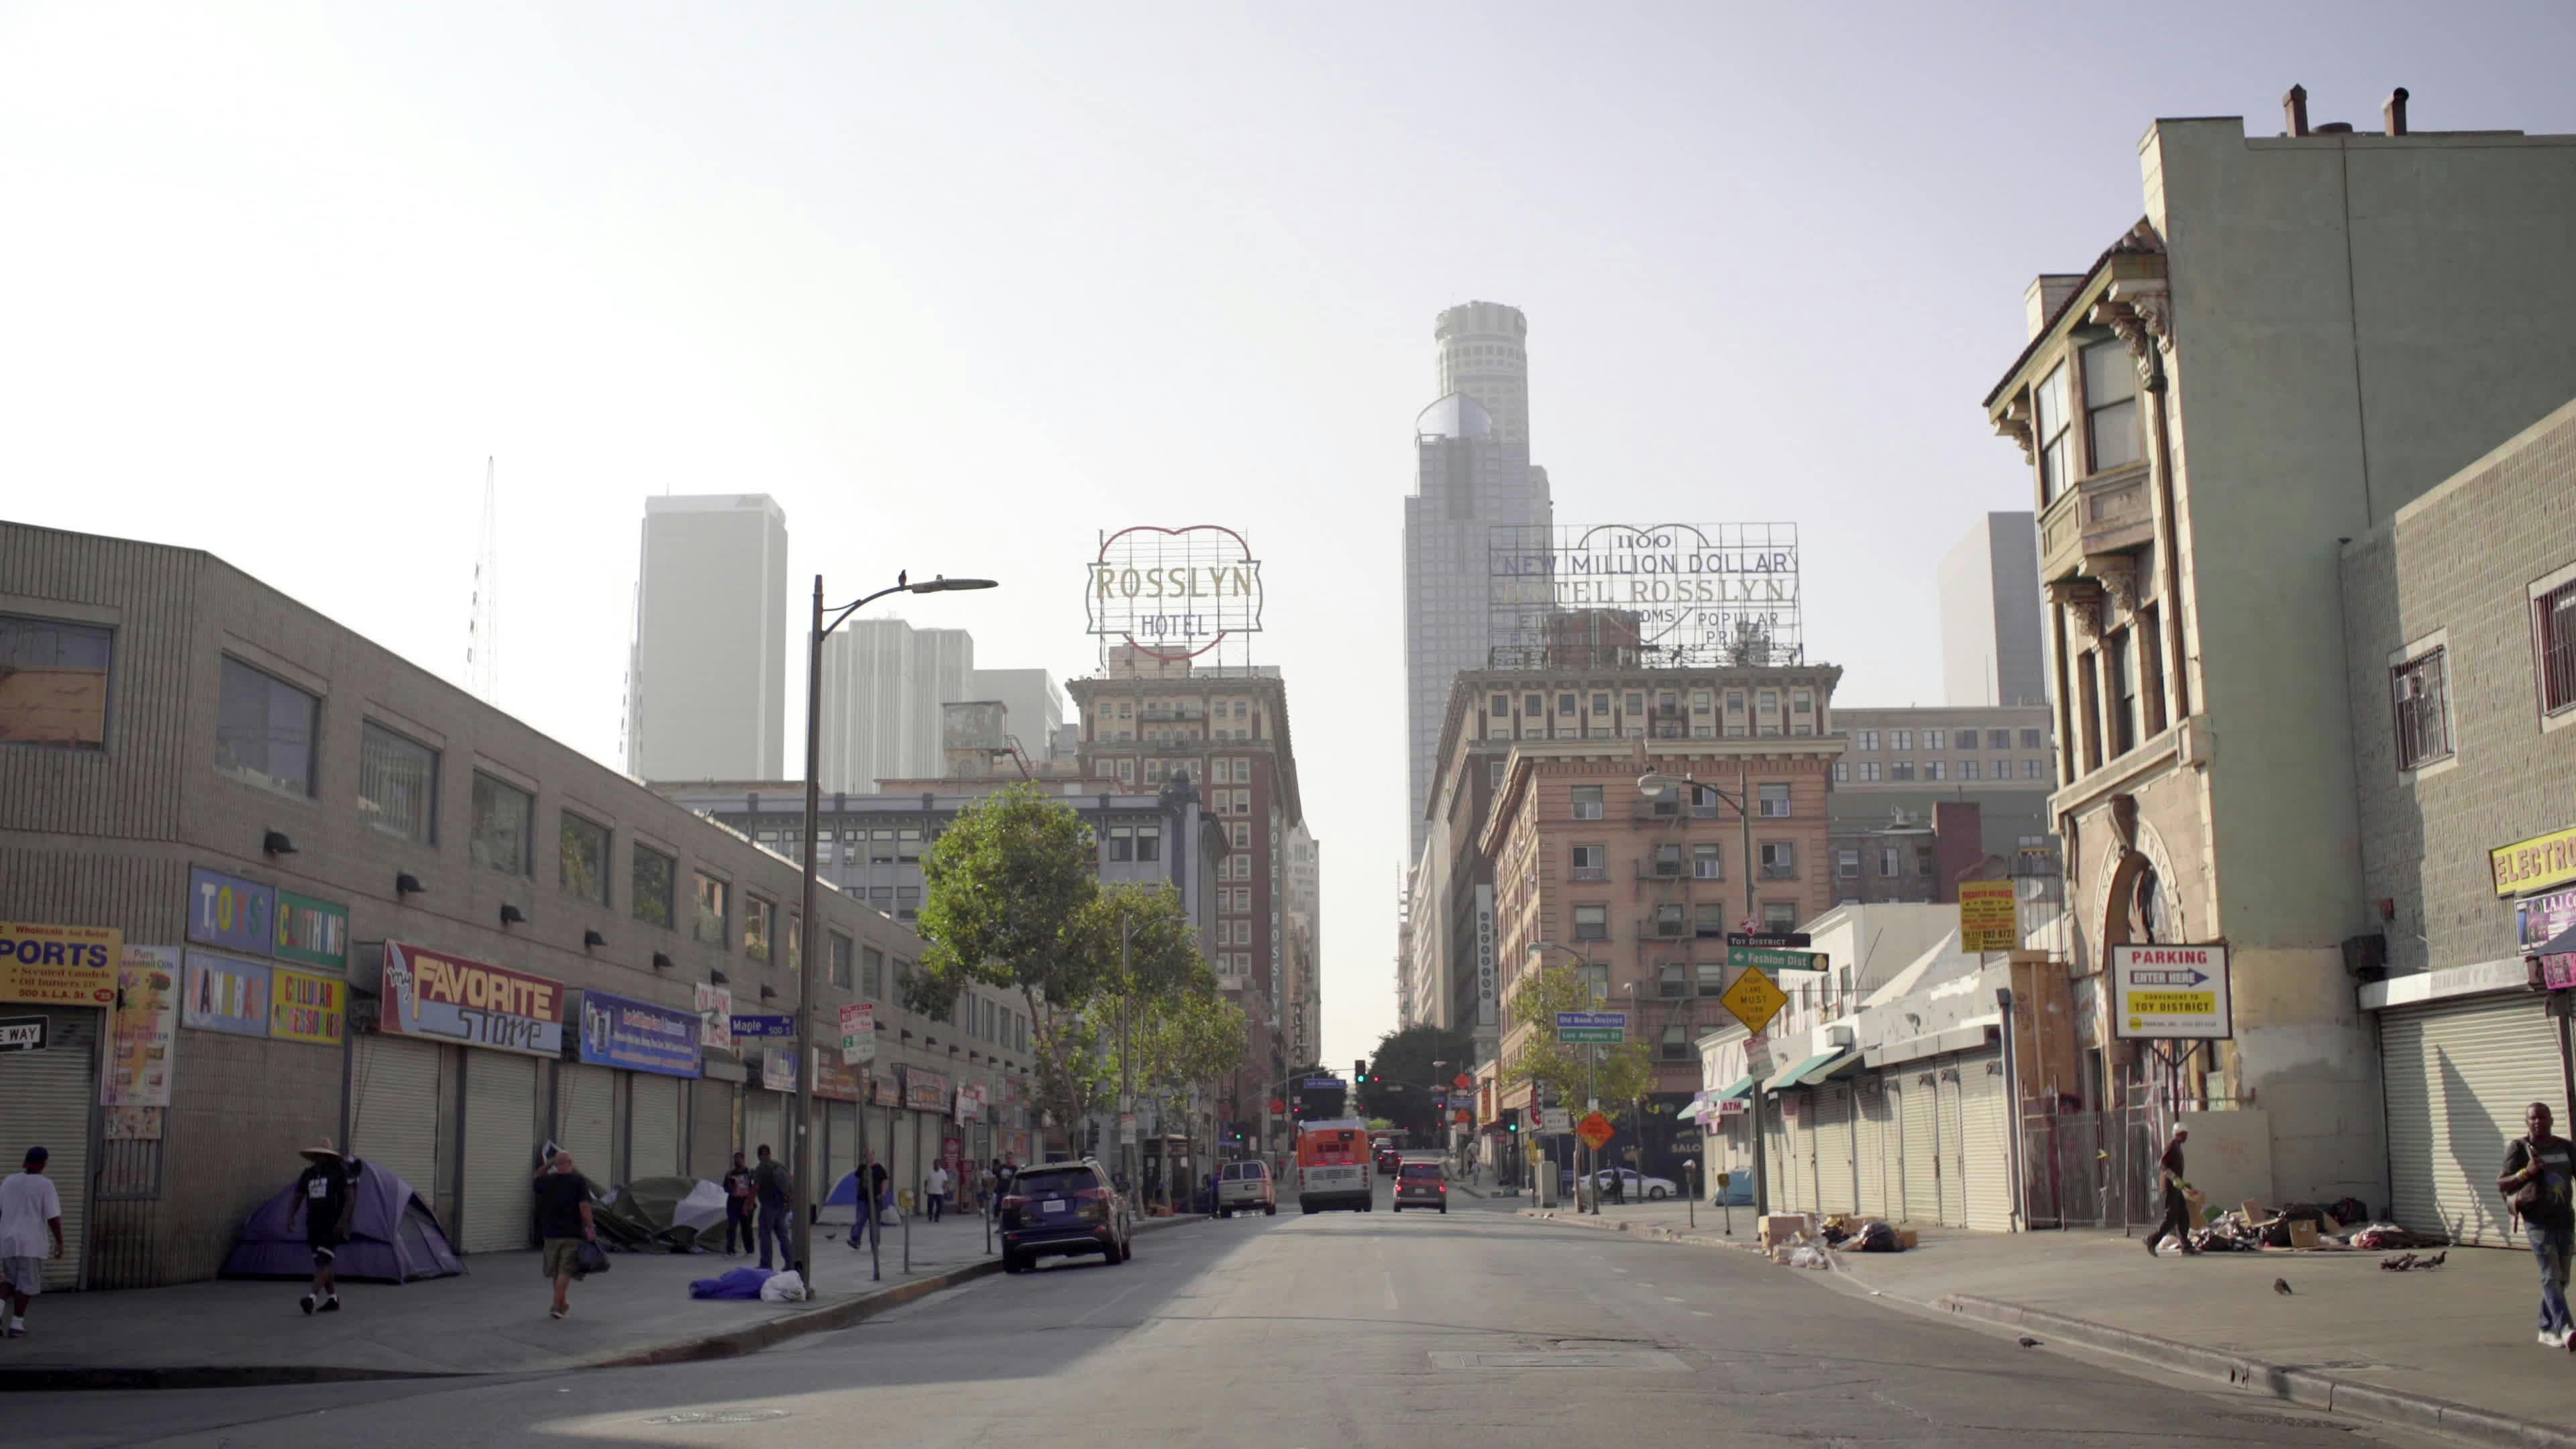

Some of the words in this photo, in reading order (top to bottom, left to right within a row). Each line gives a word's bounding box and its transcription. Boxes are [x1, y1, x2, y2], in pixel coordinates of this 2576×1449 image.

[1618, 535, 1670, 548] 1100
[1503, 555, 1556, 574] NEW
[1572, 554, 1674, 574] MILLION
[1689, 553, 1787, 573] DOLLAR
[1096, 567, 1252, 599] ROSSLYN
[1503, 581, 1613, 604] HOTEL
[1631, 580, 1784, 602] ROSSLYN
[1141, 614, 1210, 637] HOTEL
[1698, 612, 1778, 627] POPULAR
[201, 882, 264, 939] TOYS
[15, 926, 64, 934] Wholesale
[279, 902, 344, 956] CLOTHING
[1748, 953, 1784, 964] Fashion
[1788, 955, 1807, 967] Dist
[2131, 951, 2208, 964] PARKING
[2134, 971, 2165, 983] ENTER
[2168, 971, 2196, 983] HERE
[285, 975, 333, 1009] CELLULAR
[386, 966, 413, 1004] my
[413, 955, 553, 1020] FAVORITE
[1740, 996, 1767, 1004] MUST
[2135, 1003, 2154, 1012] TOY
[2159, 1003, 2210, 1012] DISTRICT
[274, 1003, 341, 1038] ACCESSORIES
[733, 1019, 762, 1034] Maple
[1560, 1016, 1572, 1024] Old
[1574, 1016, 1591, 1024] Bank
[1594, 1016, 1623, 1024] District
[10, 1026, 38, 1041] WAY
[1722, 1102, 1742, 1112] ATM
